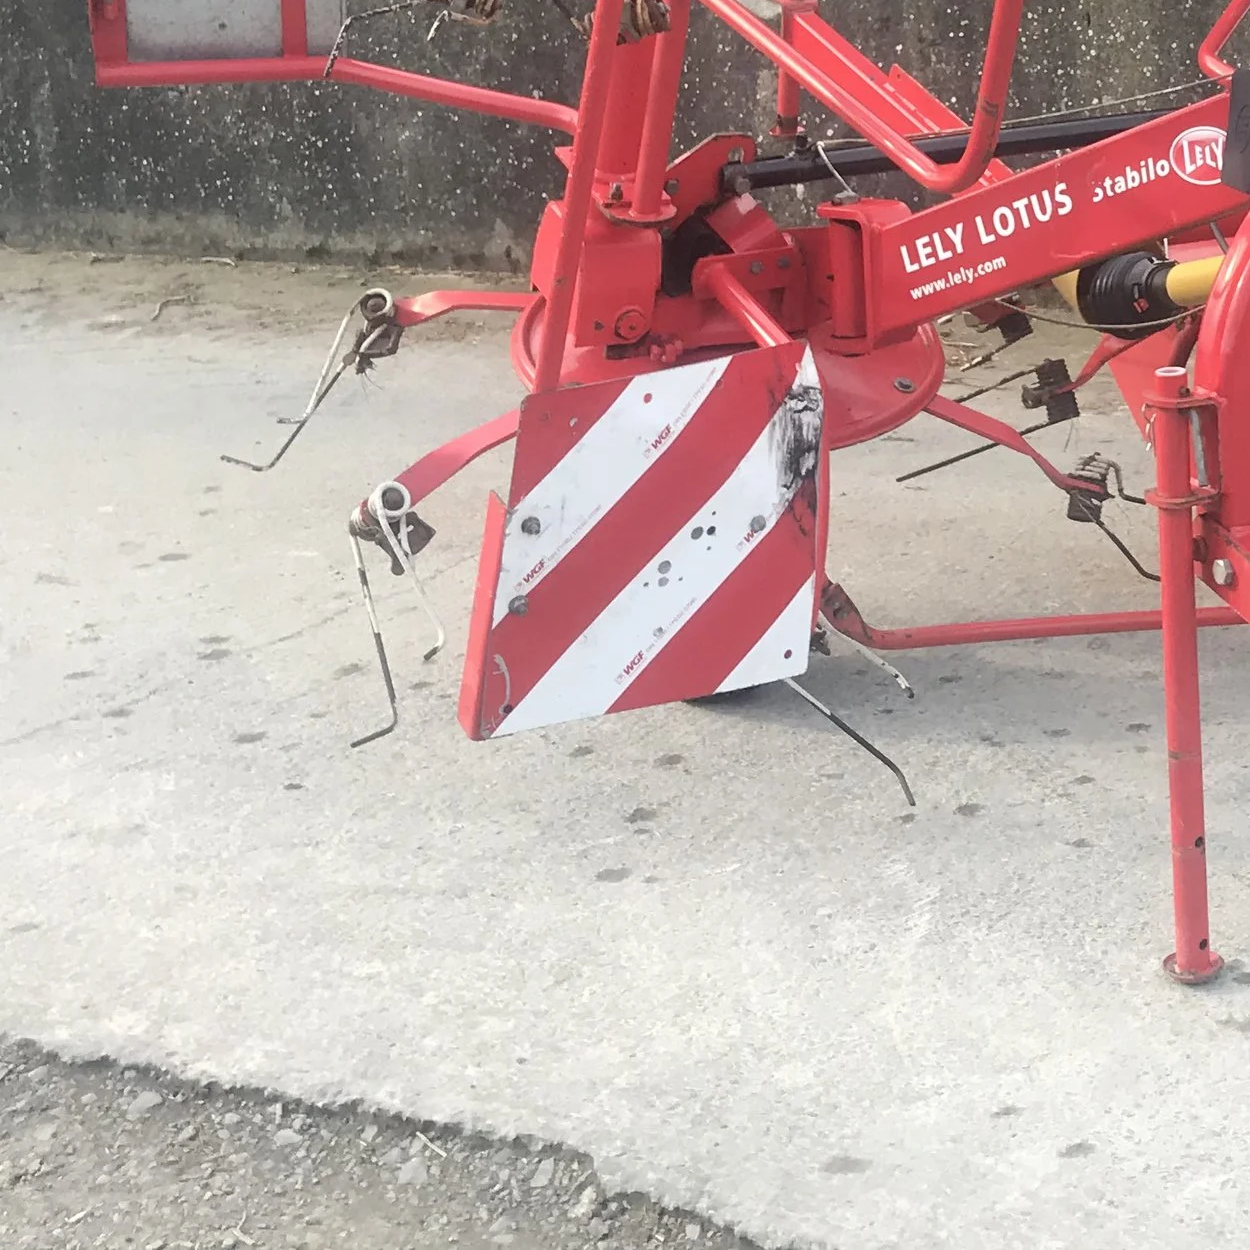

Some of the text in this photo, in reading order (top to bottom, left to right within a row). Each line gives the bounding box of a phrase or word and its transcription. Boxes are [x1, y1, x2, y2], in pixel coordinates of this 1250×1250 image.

[1181, 137, 1224, 175] LELY
[900, 222, 964, 274] LELY
[975, 182, 1073, 245] LOTUS
[910, 255, 1007, 300] www.lely.com
[651, 423, 672, 450] WGF
[522, 558, 546, 584] WGF
[623, 650, 644, 676] WGF
